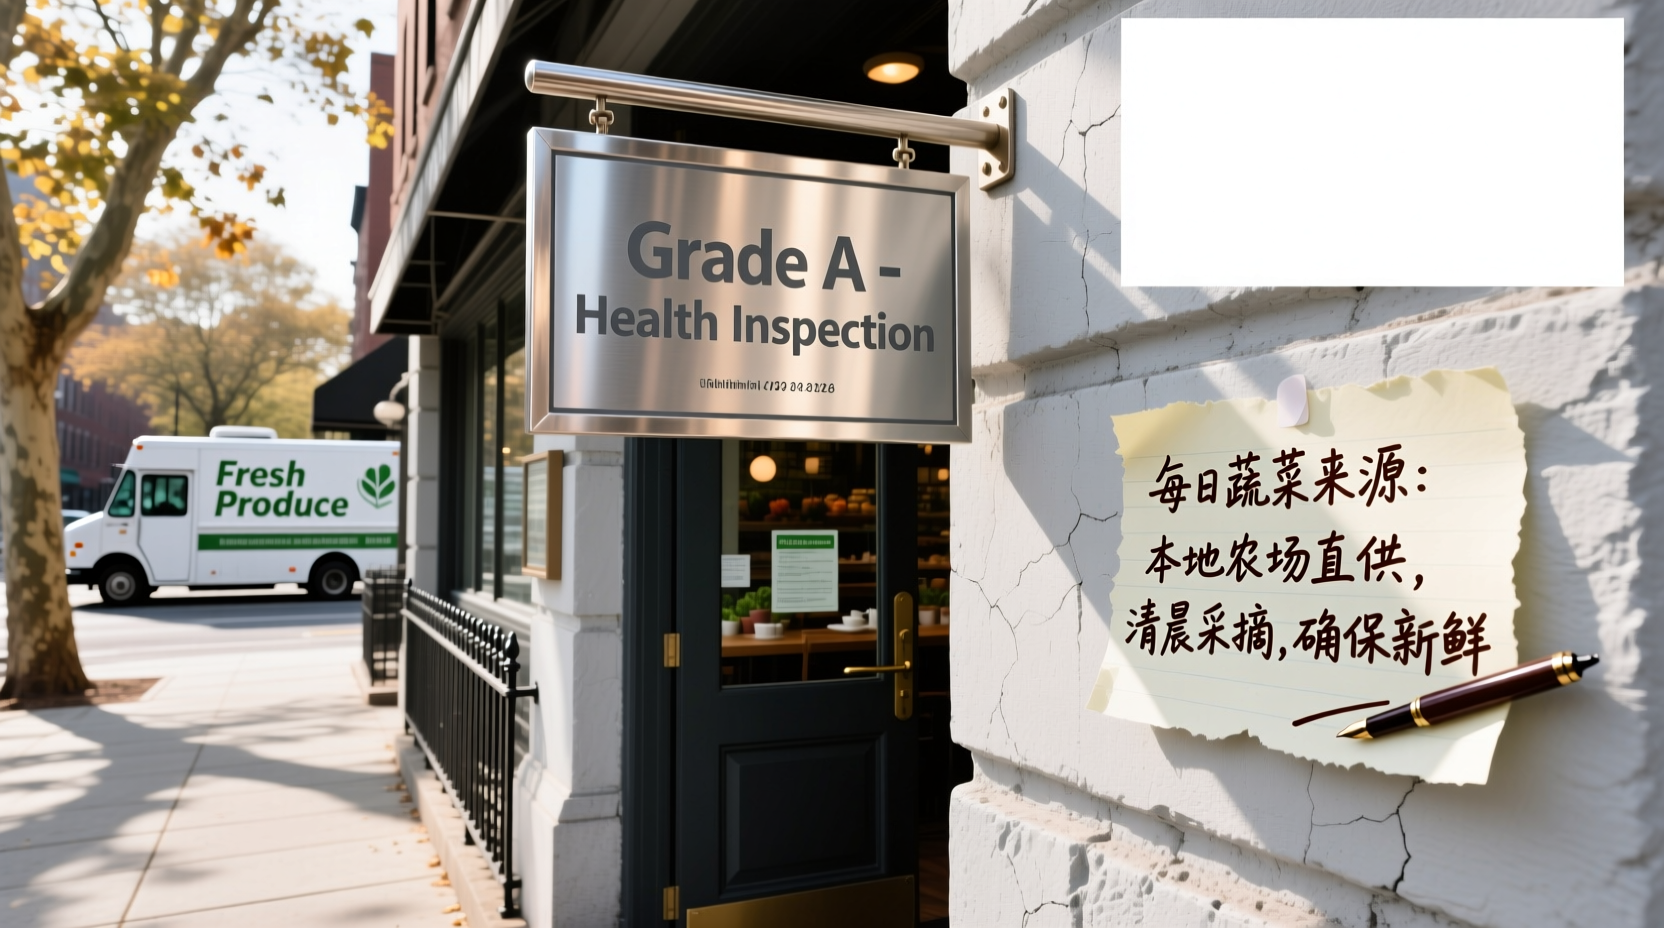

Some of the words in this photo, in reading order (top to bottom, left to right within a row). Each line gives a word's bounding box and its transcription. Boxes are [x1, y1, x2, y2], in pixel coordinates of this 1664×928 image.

[627, 220, 808, 288] Grade
[822, 235, 866, 292] A
[576, 293, 718, 341] Health
[733, 305, 935, 356] Inspection
[215, 490, 349, 517] Produce
[216, 459, 305, 487] Fresh
[1149, 443, 1427, 513] 每日蔬菜来源：
[1145, 530, 1424, 591] 本地农场直供，
